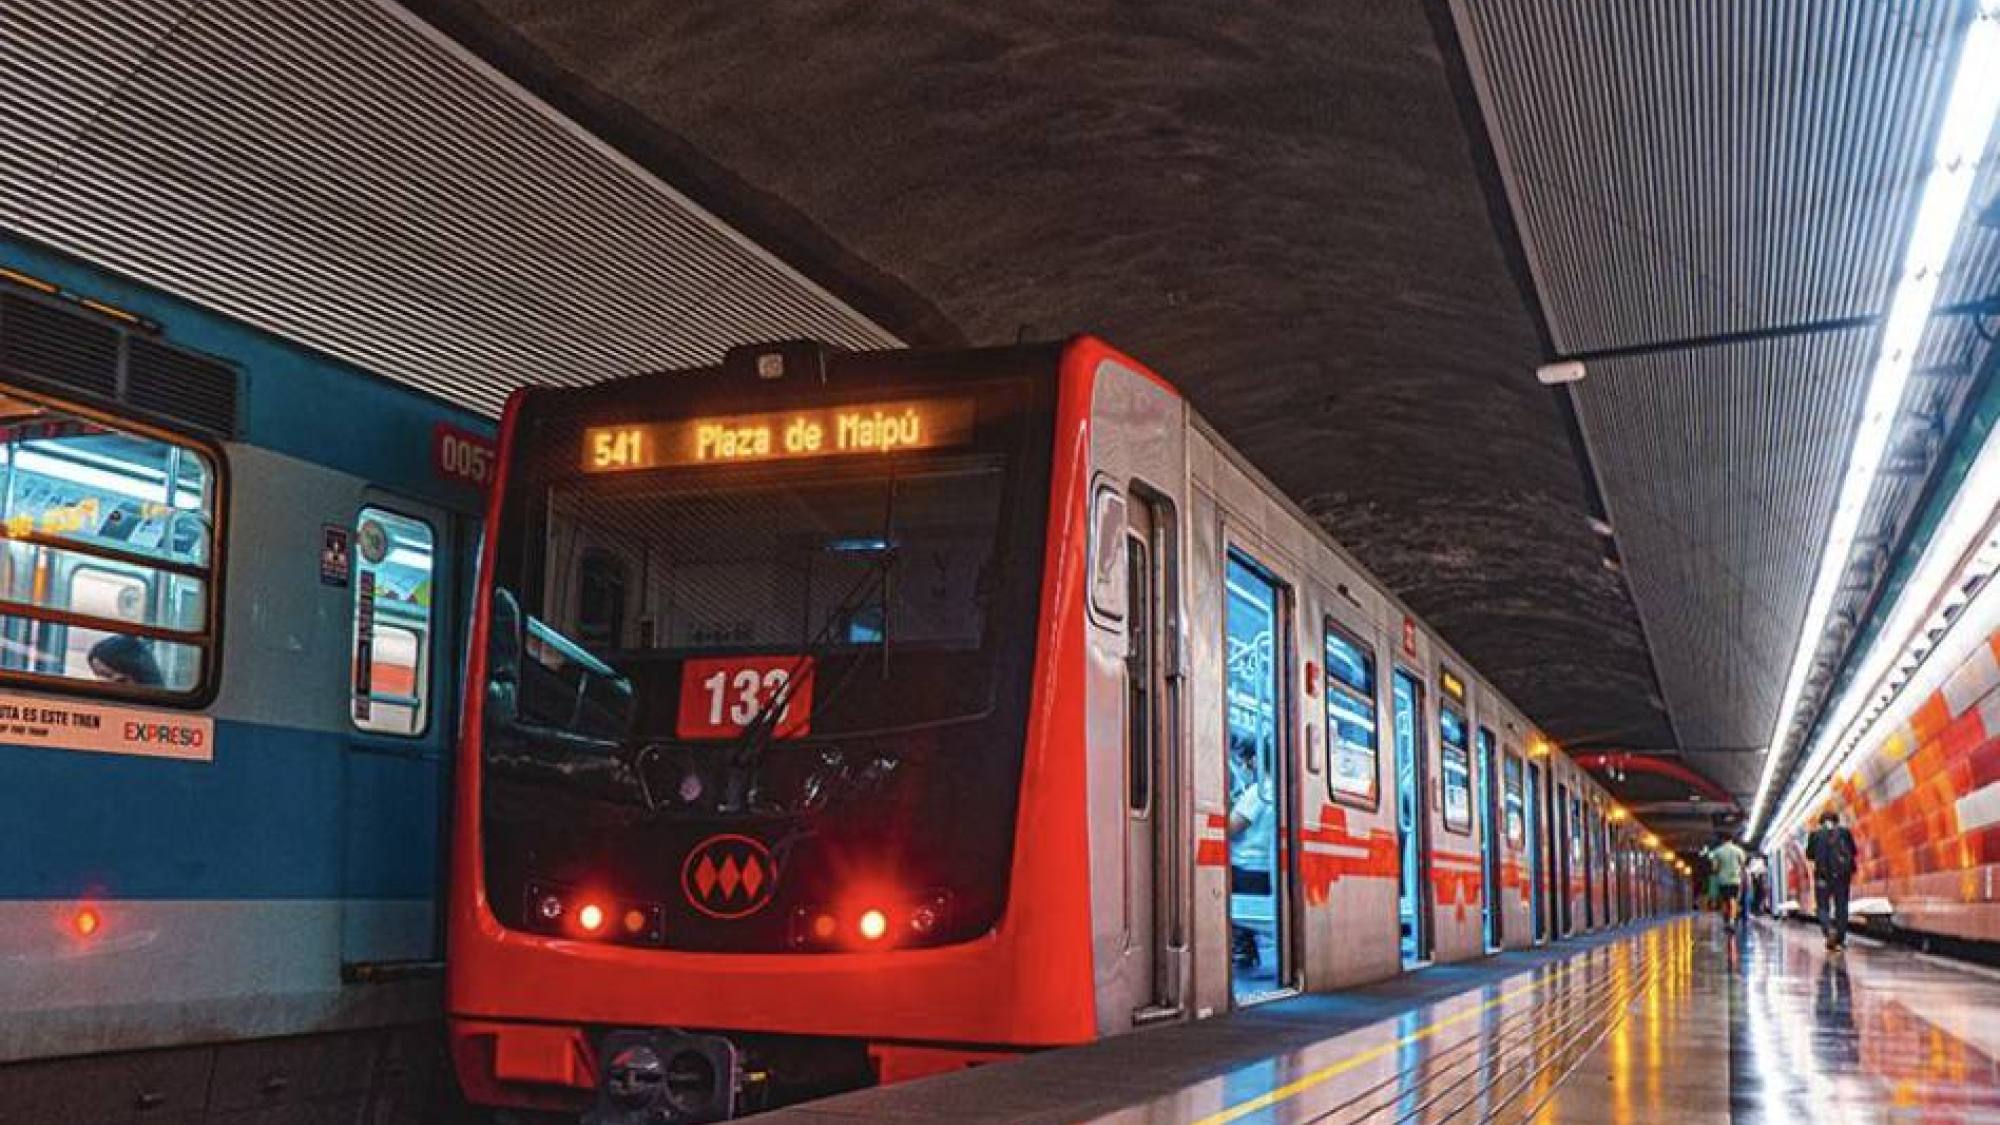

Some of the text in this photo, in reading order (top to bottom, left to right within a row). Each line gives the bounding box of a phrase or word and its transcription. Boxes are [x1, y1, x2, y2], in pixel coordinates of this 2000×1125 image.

[594, 410, 920, 466] 541 Plaza de Maipú
[23, 707, 37, 722] ES
[40, 708, 68, 726] ESTE
[124, 721, 204, 747] EXPRESO
